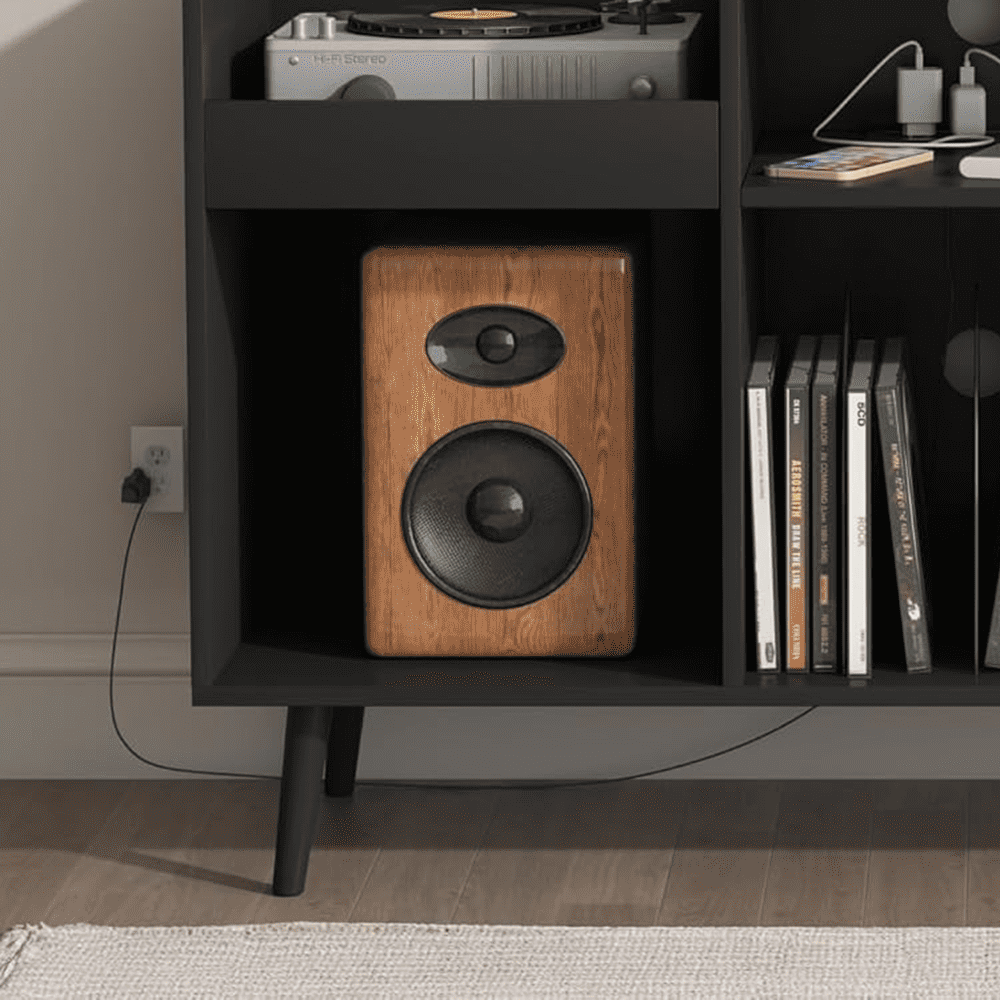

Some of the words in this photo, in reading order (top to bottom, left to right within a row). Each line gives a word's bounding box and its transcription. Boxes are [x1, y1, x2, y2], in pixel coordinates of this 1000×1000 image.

[857, 402, 865, 426] 5CD
[791, 460, 802, 518] AEROSMITH
[791, 524, 801, 549] DRAW
[791, 552, 801, 567] THE
[791, 569, 801, 590] LINE
